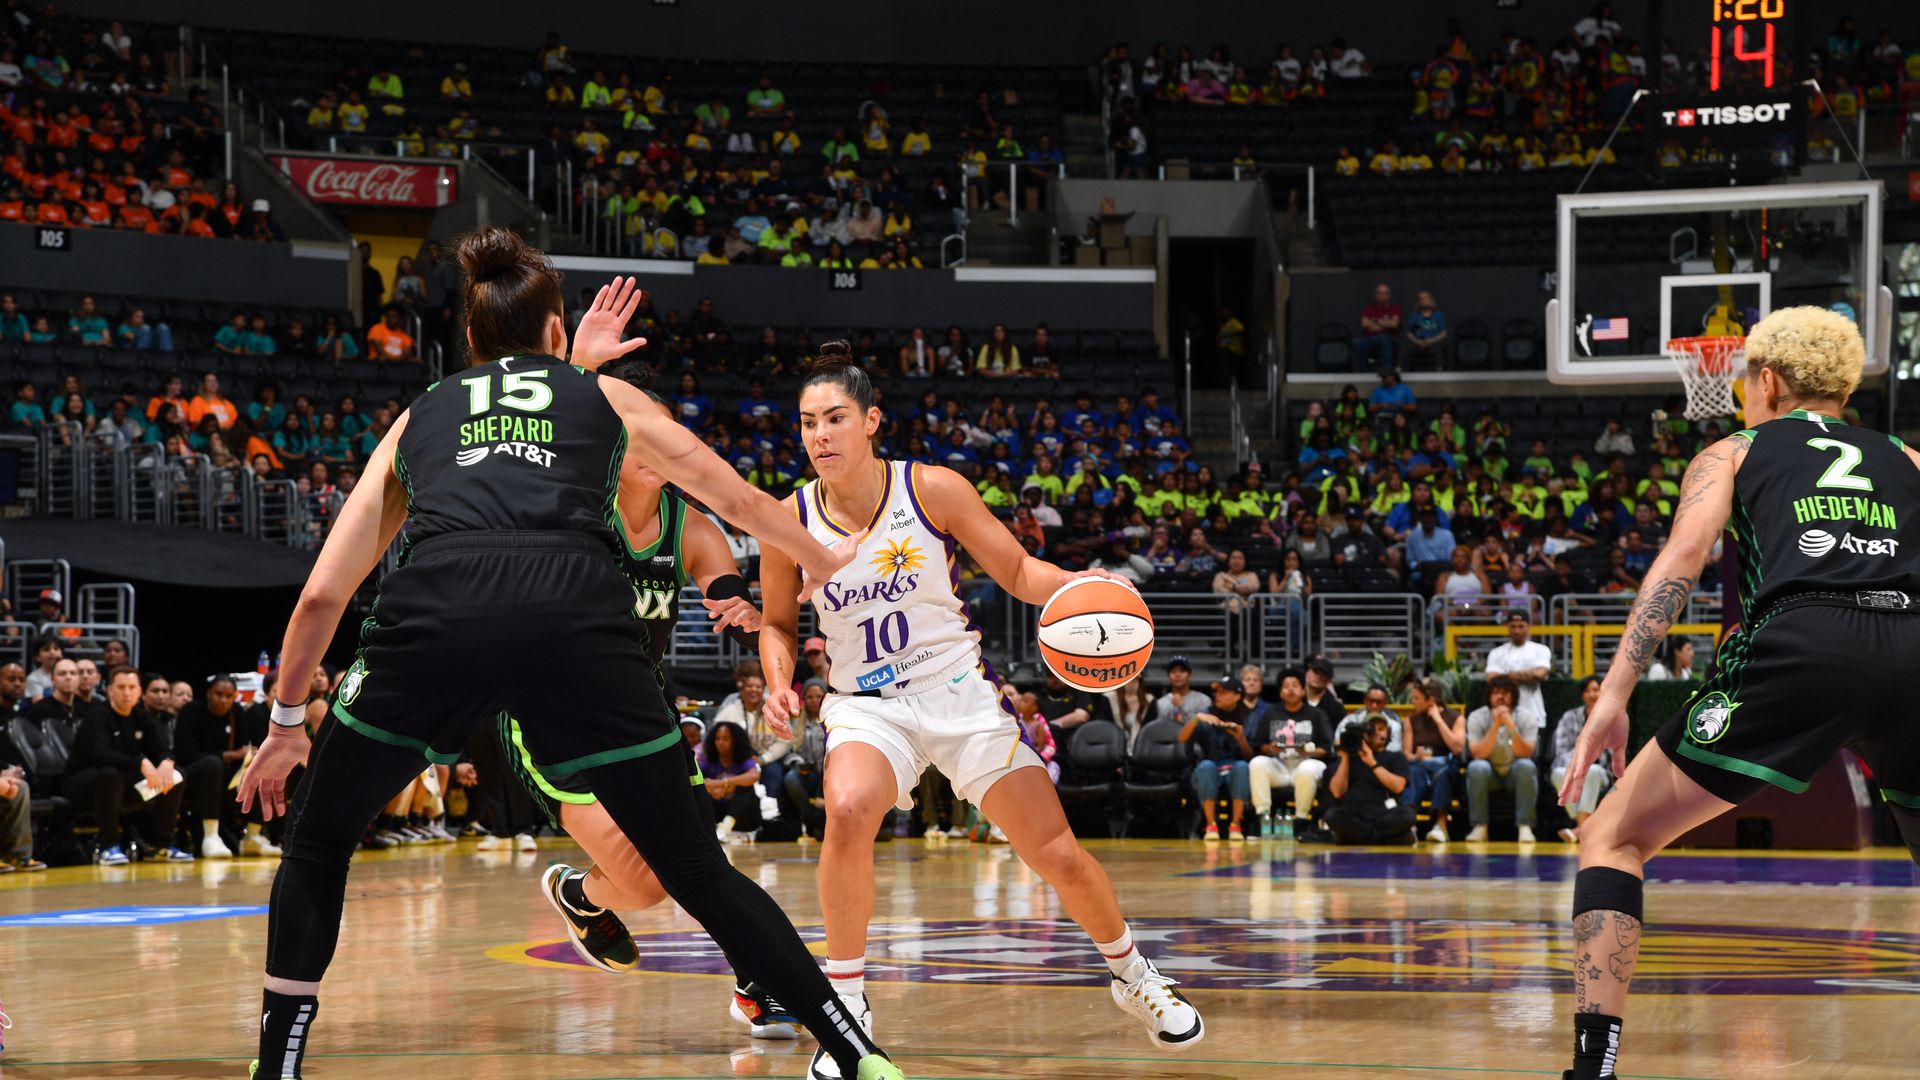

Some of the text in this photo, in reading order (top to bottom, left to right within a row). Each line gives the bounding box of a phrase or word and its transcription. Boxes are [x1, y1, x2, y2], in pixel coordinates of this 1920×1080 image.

[1710, 22, 1775, 91] 14
[1697, 103, 1791, 126] TISSOT
[307, 161, 420, 202] Coca-Cola
[40, 229, 65, 248] 105
[834, 272, 857, 289] 106
[461, 369, 553, 415] 15
[460, 415, 553, 446] SHEPARD
[493, 441, 557, 468] AT&T
[1806, 437, 1873, 492] 2
[890, 516, 916, 532] Albert
[1793, 495, 1897, 530] HIEDEMAN
[1839, 531, 1899, 557] AT&T
[857, 610, 909, 663] 10
[861, 650, 933, 688] UCLA Health
[1064, 660, 1137, 682] Wilson
[1577, 959, 1586, 1014] ASSION
